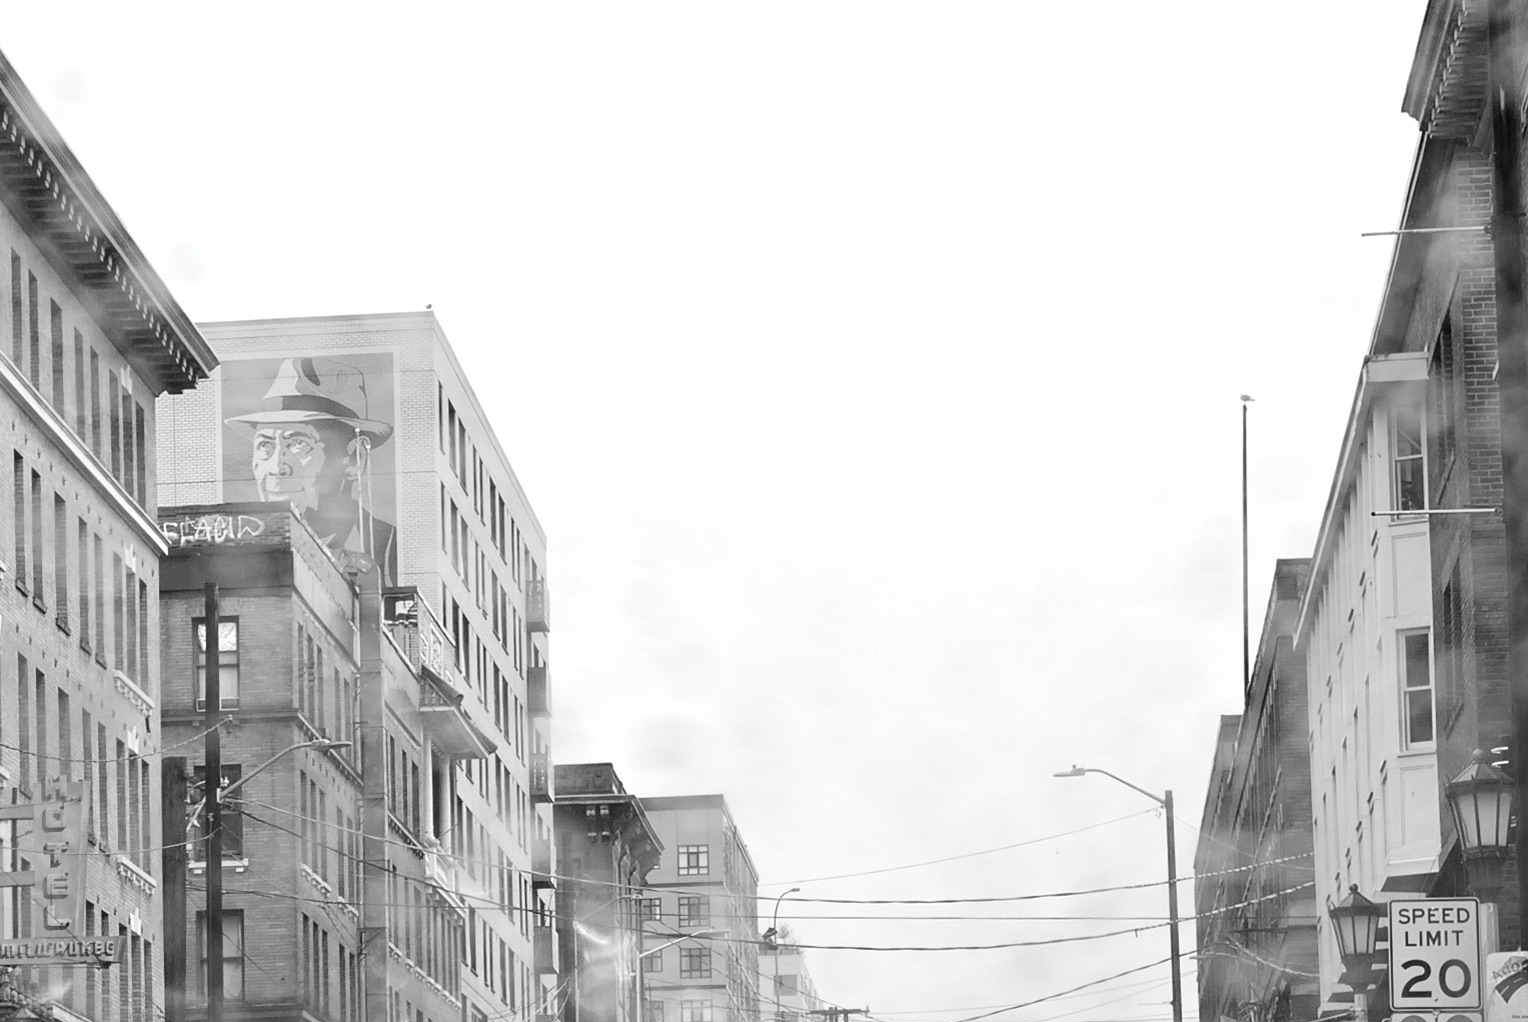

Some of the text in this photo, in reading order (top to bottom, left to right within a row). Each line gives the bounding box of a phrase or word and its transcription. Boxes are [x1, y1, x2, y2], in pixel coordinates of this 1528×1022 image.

[42, 774, 72, 931] HOTEL
[1398, 908, 1471, 925] SPEED
[1404, 930, 1464, 947] LIMIT
[1400, 958, 1472, 999] 20
